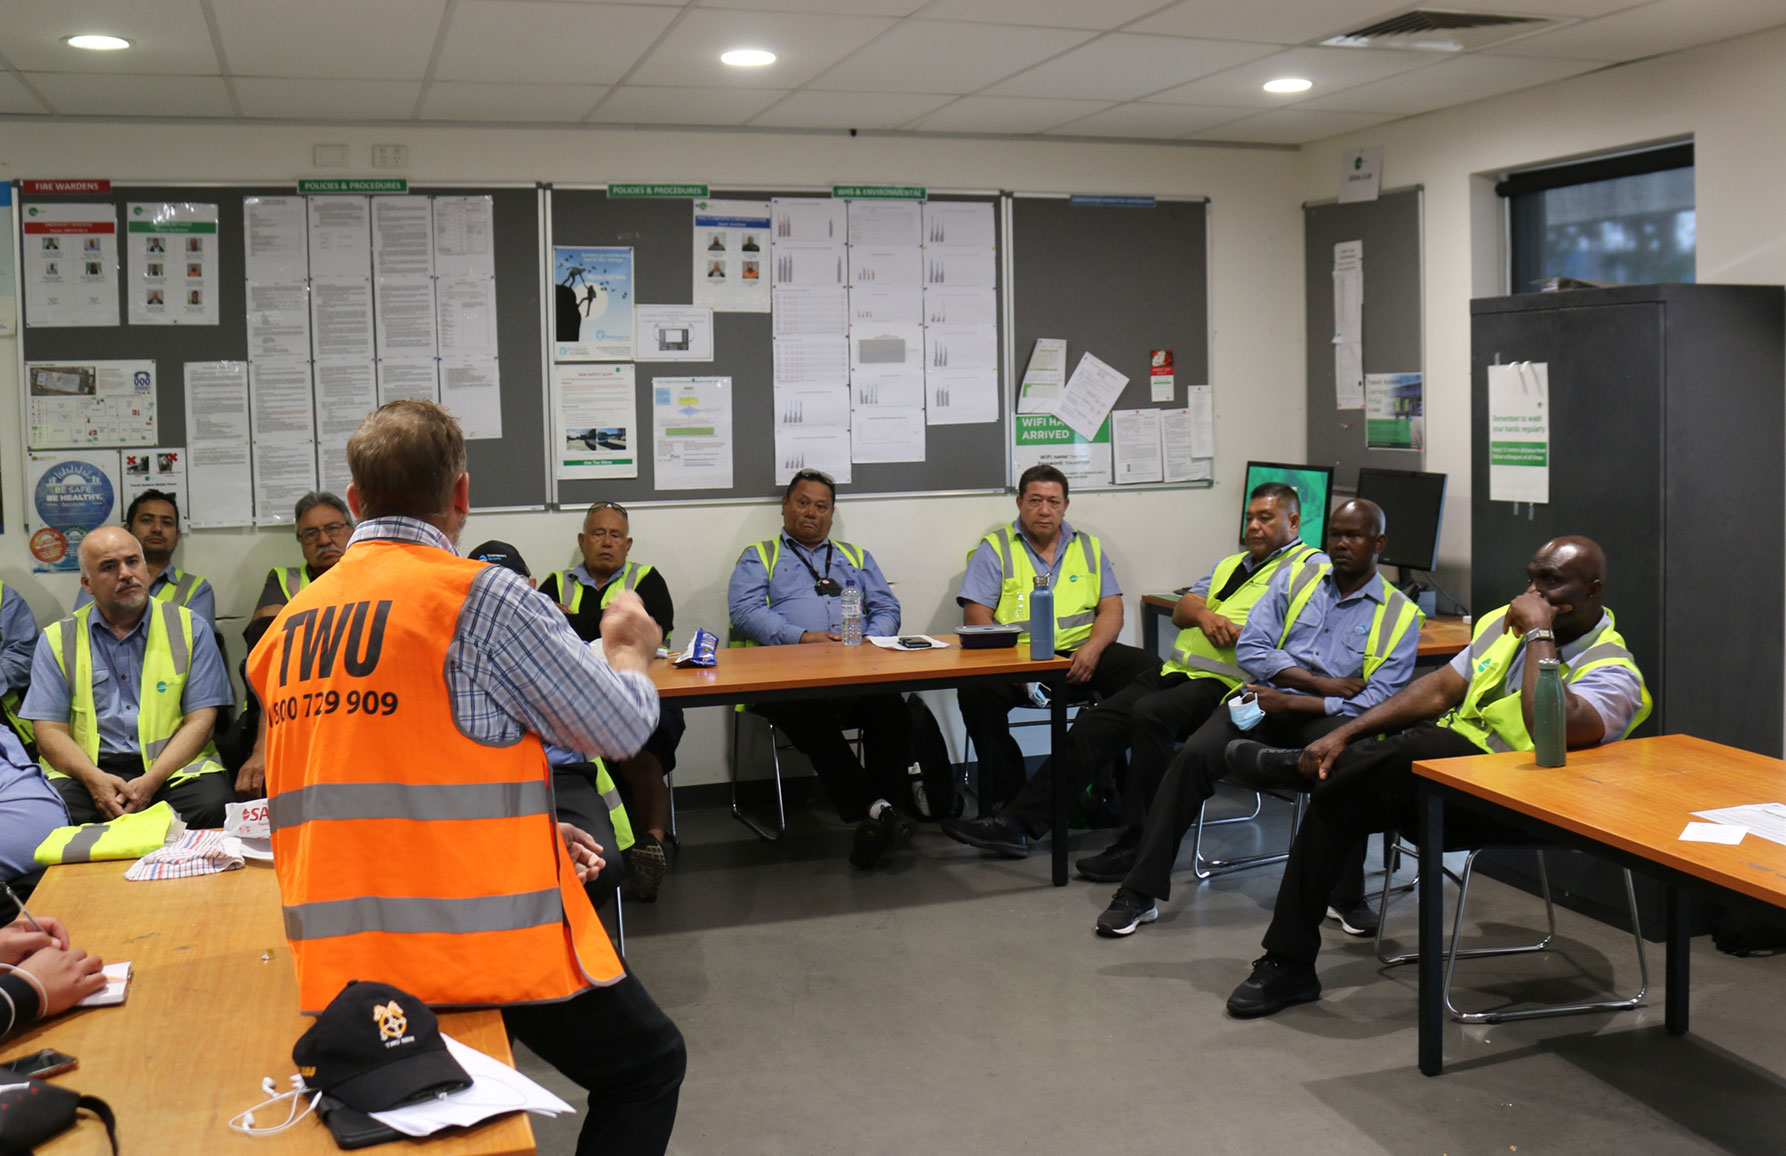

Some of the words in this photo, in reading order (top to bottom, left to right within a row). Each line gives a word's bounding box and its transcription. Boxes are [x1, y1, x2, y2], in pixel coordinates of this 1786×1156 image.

[35, 182, 53, 190] FIRE
[55, 182, 99, 191] WARDENS
[304, 182, 339, 190] POLICIES
[349, 181, 401, 189] PROCEDURES
[613, 186, 645, 194] POLICIES
[837, 188, 854, 196] WHS
[855, 188, 862, 196] &
[863, 188, 922, 197] ENVIRONMENTAL
[1049, 418, 1065, 427] HA
[1022, 430, 1070, 440] ARRIVED
[279, 600, 393, 688] TWU
[303, 690, 340, 718] 729
[346, 690, 399, 716] 909
[249, 806, 270, 822] SA
